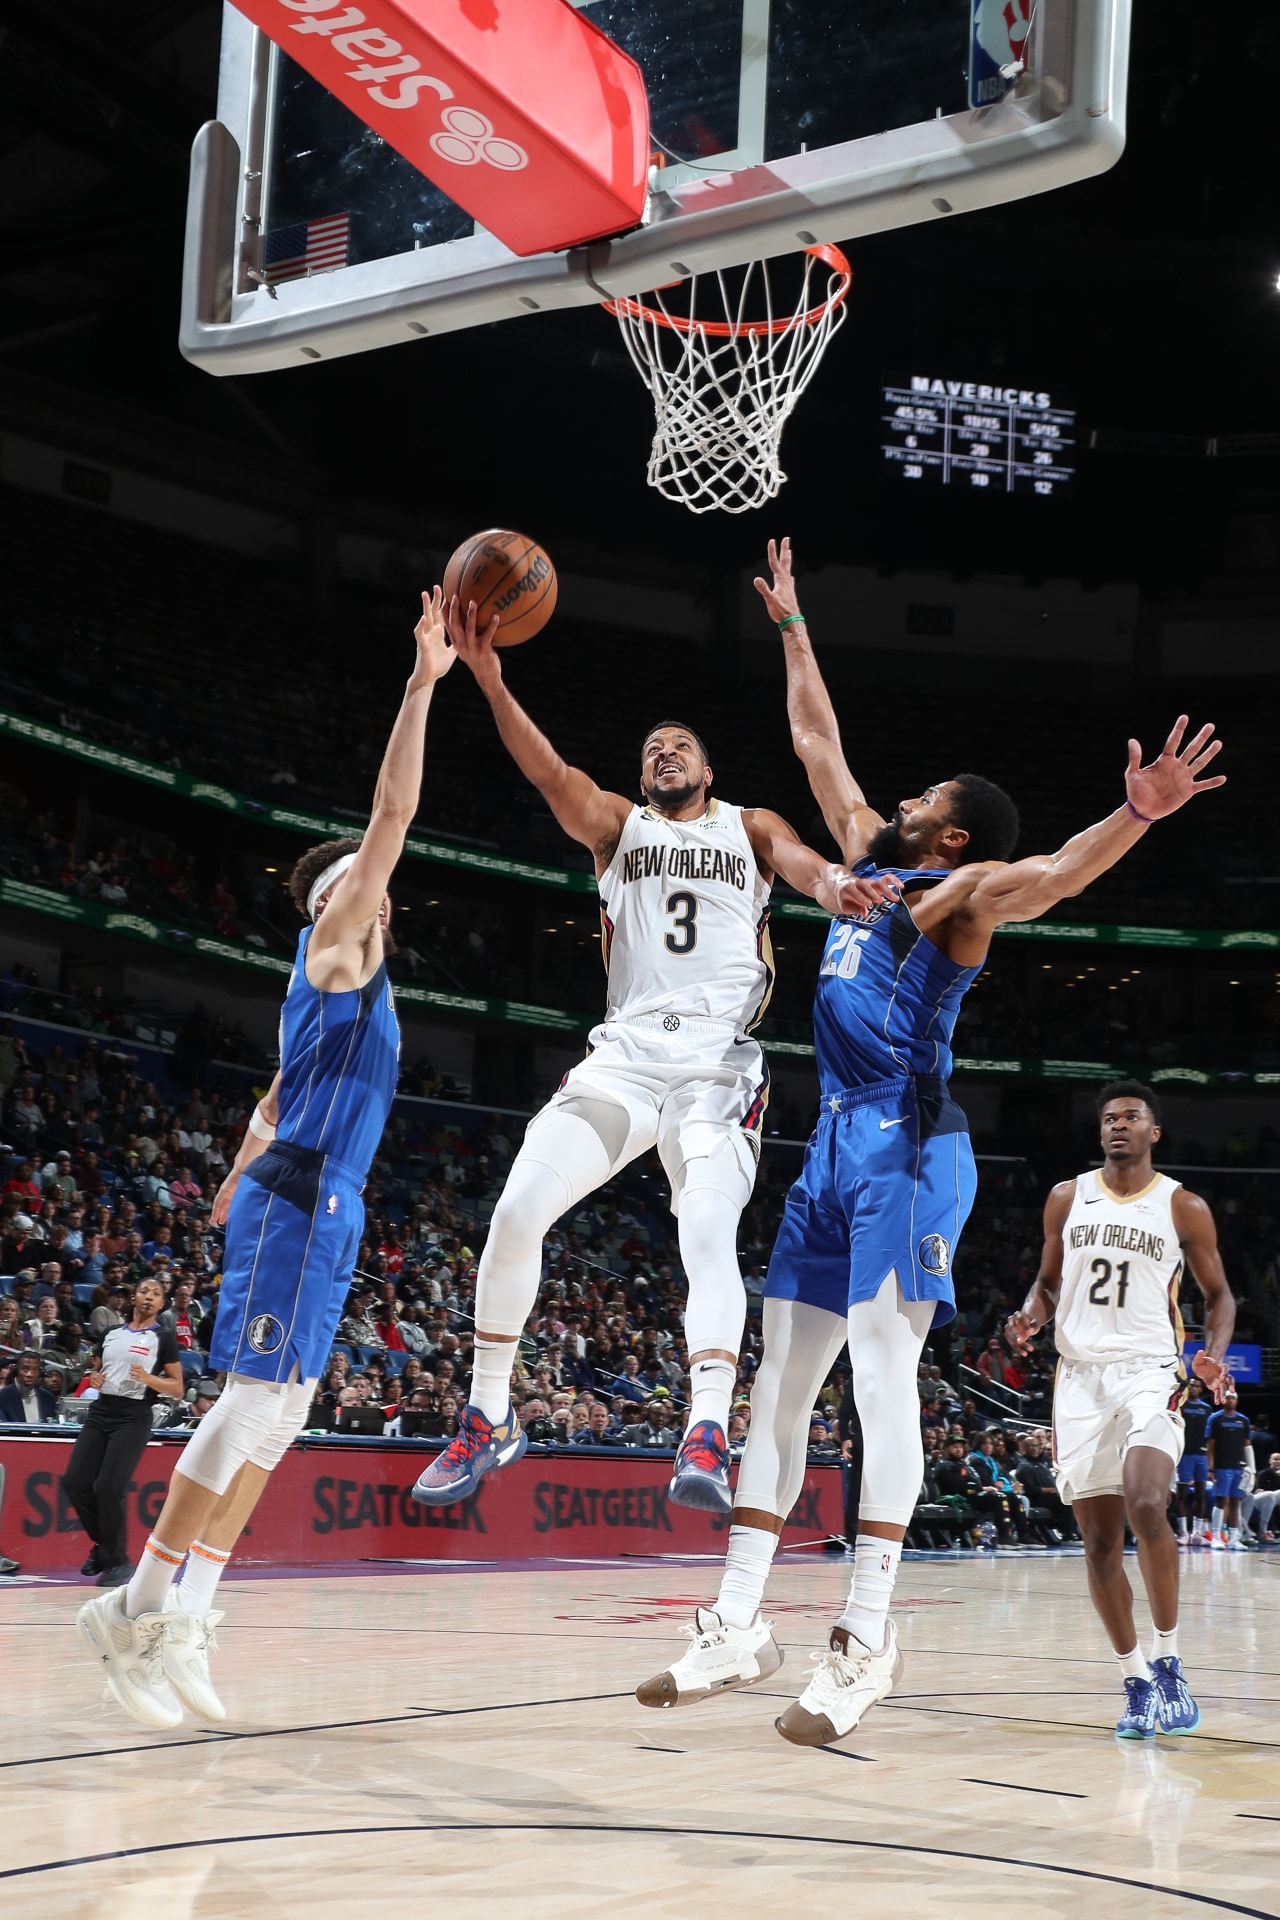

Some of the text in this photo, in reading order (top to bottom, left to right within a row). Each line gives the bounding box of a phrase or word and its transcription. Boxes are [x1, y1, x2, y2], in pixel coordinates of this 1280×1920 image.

[911, 376, 1050, 409] MAVERICKS
[493, 555, 550, 611] Wilson
[189, 784, 238, 809] JAMESON
[270, 809, 329, 832] OFFICIAL
[623, 845, 666, 886] NEW
[667, 847, 747, 891] ORLEANS
[104, 914, 159, 940] JAMESON
[663, 889, 698, 956] 3
[1034, 924, 1098, 938] PELICANS
[195, 937, 246, 961] OFFICIAL
[820, 924, 873, 979] 26
[426, 991, 489, 1012] PELICANS
[952, 1058, 1022, 1072] PELICANS
[1150, 1067, 1211, 1084] JAMESON
[1070, 1223, 1165, 1262] NEW ORLEANS
[1089, 1257, 1130, 1309] 21
[534, 1481, 674, 1533] SEATGEEK
